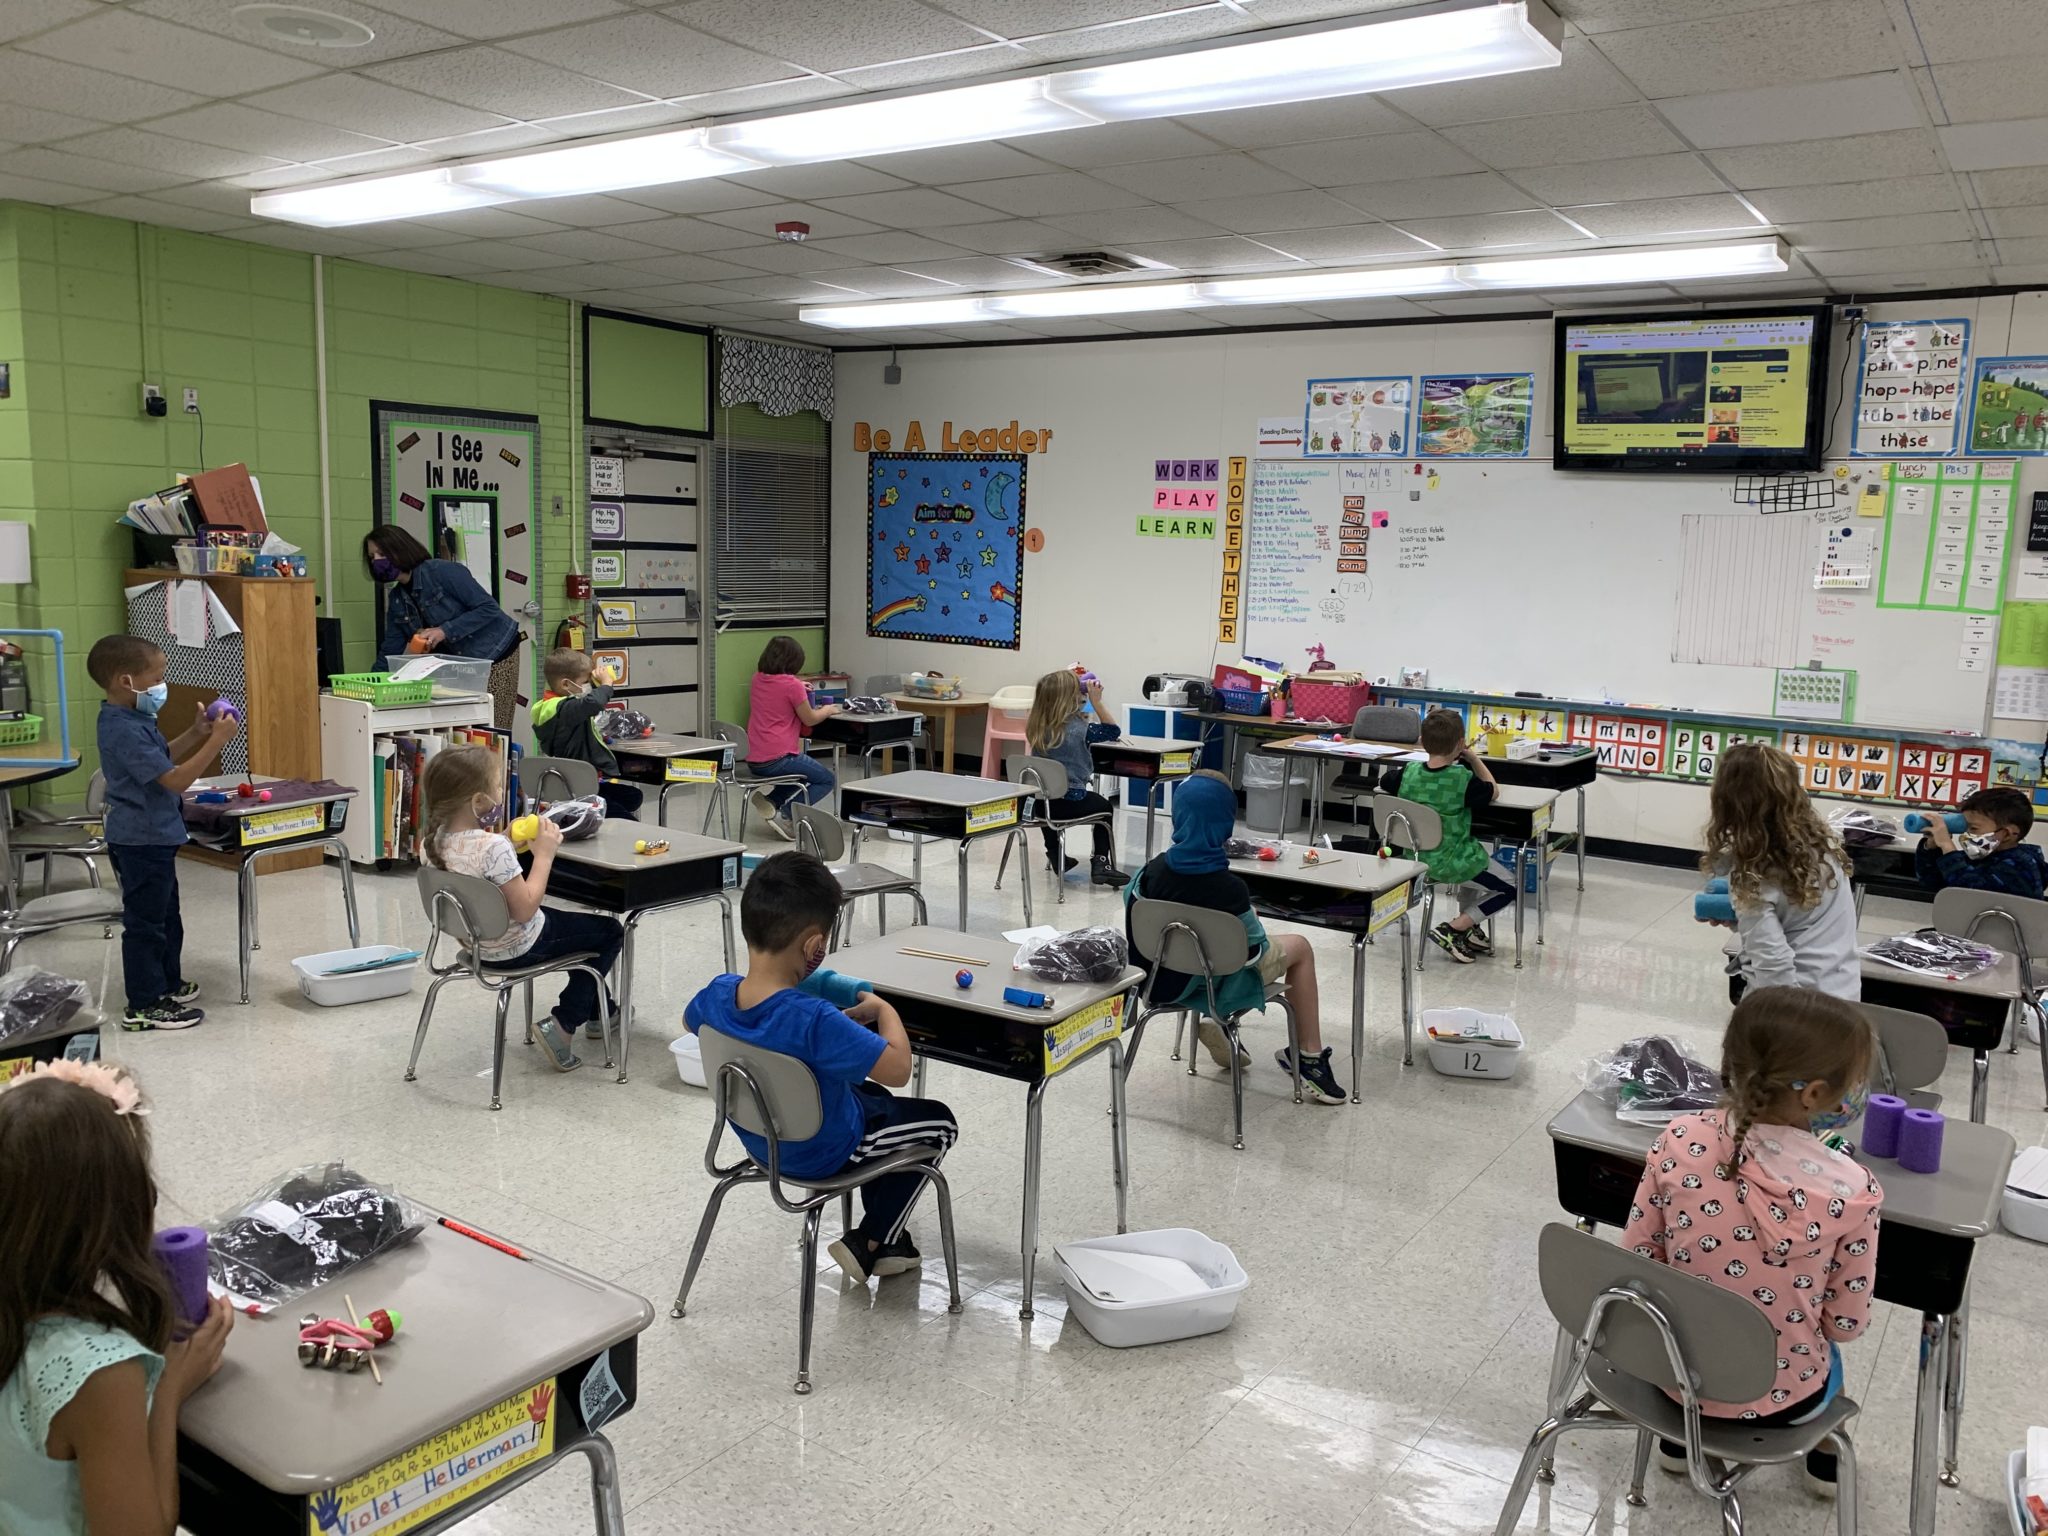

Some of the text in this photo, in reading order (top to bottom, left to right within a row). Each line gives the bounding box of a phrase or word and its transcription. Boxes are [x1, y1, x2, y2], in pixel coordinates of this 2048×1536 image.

[1865, 383, 1898, 401] hop
[853, 420, 1053, 454] Be A Leader
[1259, 427, 1281, 437] Reading
[437, 431, 443, 460] I
[451, 434, 484, 463] See
[1156, 463, 1217, 478] WORK
[1898, 463, 1928, 472] Lunch
[1157, 492, 1215, 508] PLAY
[1345, 498, 1362, 507] run
[606, 509, 616, 518] Hip
[916, 508, 936, 519] Aim
[954, 507, 972, 519] the
[1344, 513, 1361, 523] not
[595, 517, 615, 526] Hooray
[1139, 519, 1213, 535] LEARN
[1342, 528, 1367, 540] jump
[1222, 461, 1244, 639] TOGETHER
[1342, 545, 1364, 554] look
[597, 558, 615, 566] Ready
[1339, 562, 1365, 570] come
[612, 664, 621, 673] Up
[1599, 724, 1615, 736] m
[1625, 726, 1637, 738] n
[1646, 728, 1657, 740] o
[1678, 732, 1714, 751] p q
[1597, 747, 1656, 767] M N O
[1907, 751, 1922, 766] x
[1966, 757, 1979, 771] z
[1675, 754, 1713, 775] P Q
[248, 826, 267, 837] Jack
[1103, 1015, 1113, 1029] 13
[1464, 1051, 1489, 1073] 12
[509, 1395, 526, 1409] Mm
[344, 1492, 359, 1506] Nn
[360, 1484, 375, 1498] Oo
[377, 1475, 390, 1490] Pp
[392, 1468, 406, 1482] Qq
[407, 1460, 420, 1474] Rr
[447, 1443, 459, 1456] Uu
[460, 1436, 472, 1449] Vv
[473, 1429, 489, 1442] Ww
[491, 1421, 502, 1433] Xx
[503, 1414, 514, 1427] Yy
[515, 1408, 526, 1422] Zz
[336, 1418, 547, 1536] Violet Helderman 17
